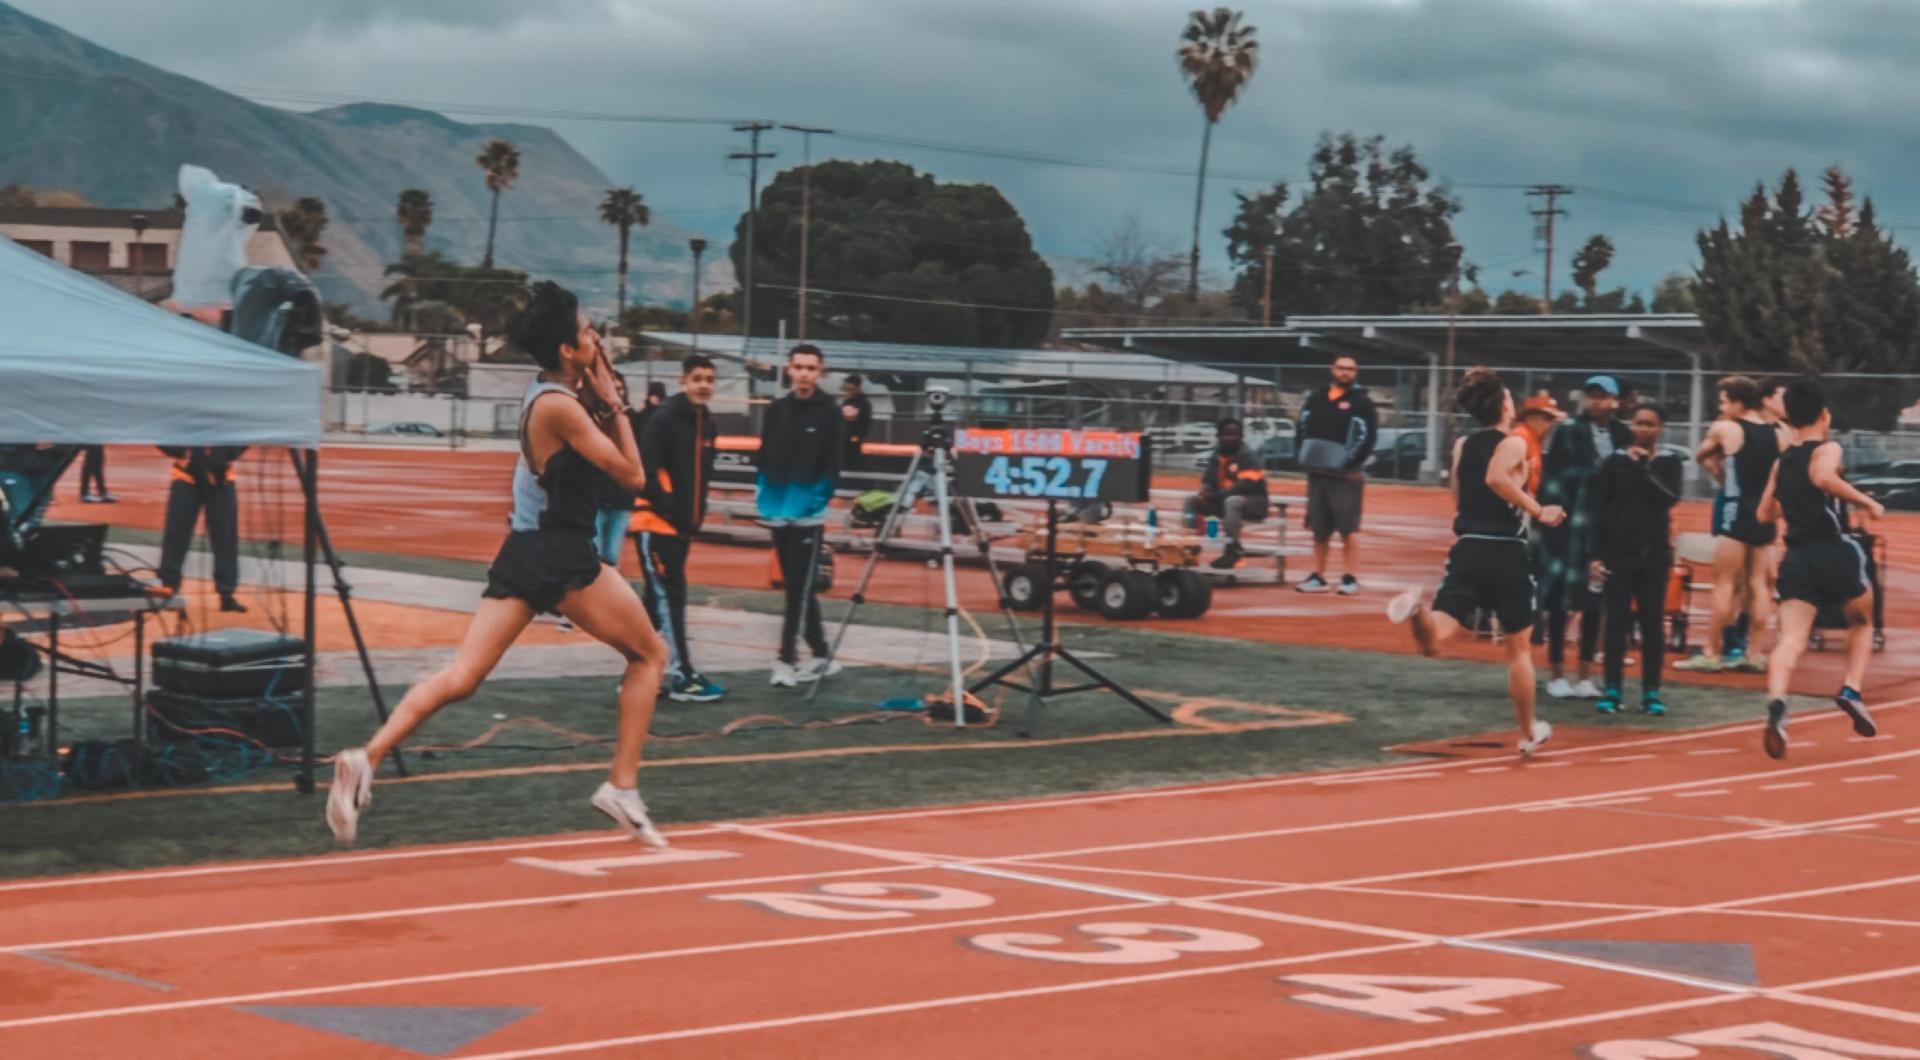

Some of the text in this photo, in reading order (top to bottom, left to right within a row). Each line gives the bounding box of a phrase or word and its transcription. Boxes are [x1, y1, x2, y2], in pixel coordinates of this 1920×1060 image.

[954, 429, 1003, 455] Boys
[1069, 432, 1141, 459] Varsity
[984, 456, 1107, 498] 4:52.7
[511, 850, 742, 876] 1
[707, 882, 996, 920] 2
[960, 922, 1263, 964] 3
[1278, 973, 1564, 1023] 4
